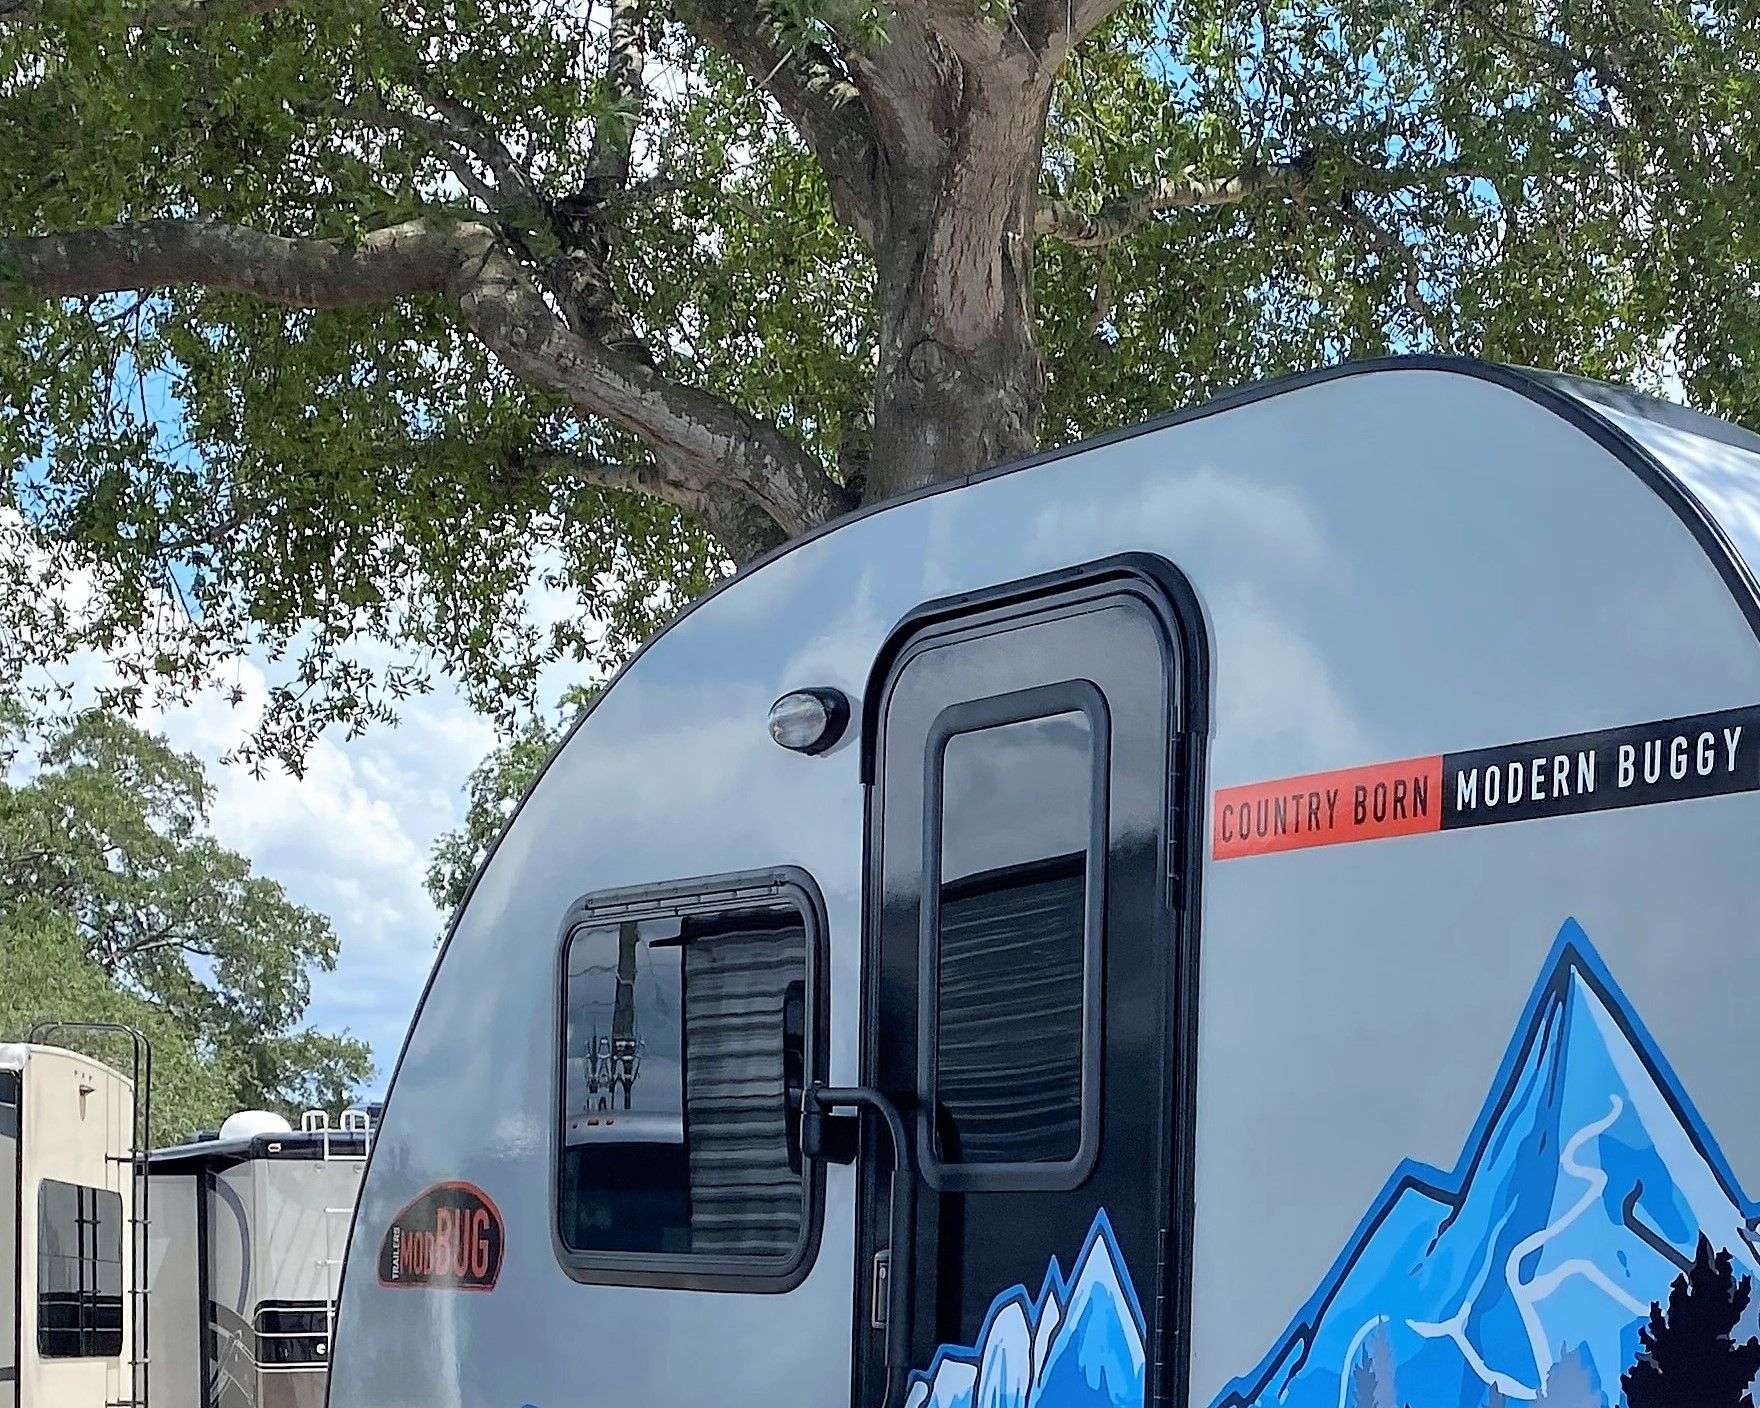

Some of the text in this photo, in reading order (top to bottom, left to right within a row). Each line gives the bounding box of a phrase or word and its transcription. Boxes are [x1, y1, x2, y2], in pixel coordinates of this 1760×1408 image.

[1221, 725, 1743, 844] COUNTRY BORN MODERN BUGGY
[391, 1226, 401, 1280] TRAILERS
